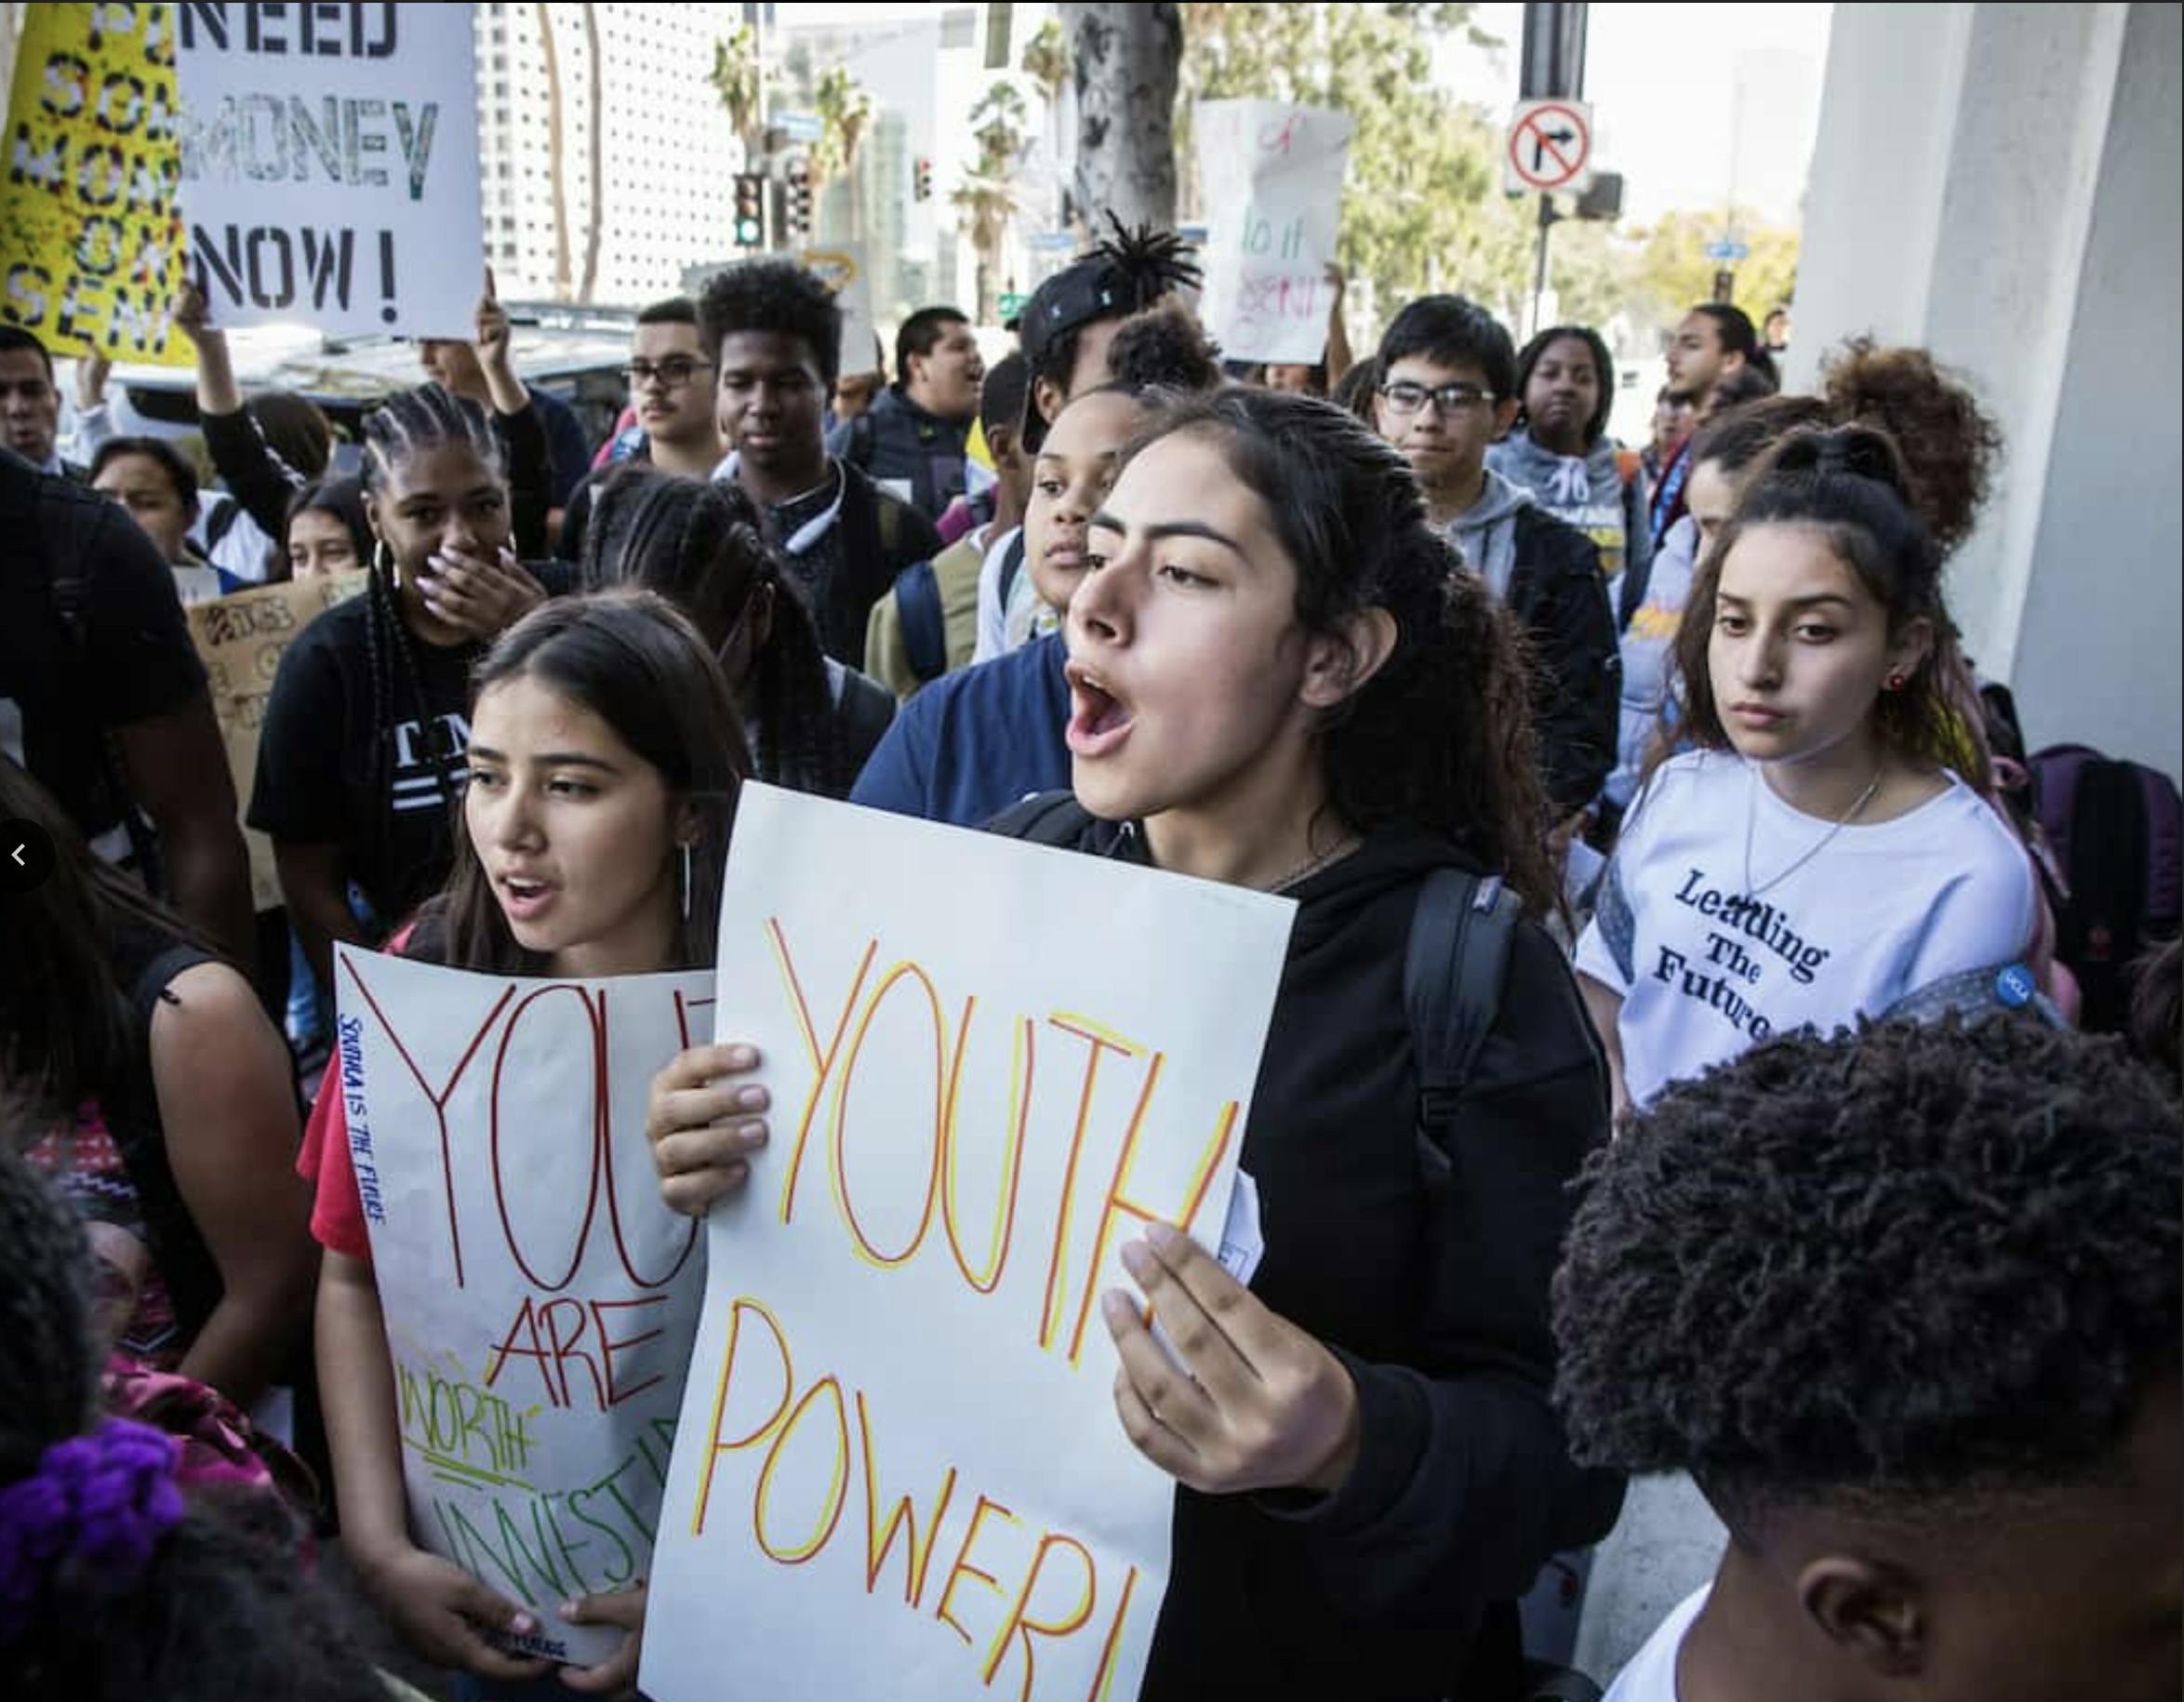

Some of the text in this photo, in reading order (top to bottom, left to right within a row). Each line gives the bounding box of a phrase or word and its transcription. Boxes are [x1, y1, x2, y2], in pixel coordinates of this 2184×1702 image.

[180, 3, 397, 58] NEED
[10, 122, 181, 215] MON
[180, 93, 438, 200] MONEY
[192, 223, 397, 324] NOW!
[1675, 868, 1830, 984] Leading
[1705, 932, 1761, 984] The
[1652, 945, 1771, 1043] Future
[340, 951, 715, 1291] YOU
[345, 1093, 367, 1116] IS
[763, 916, 1241, 1369] YOUTH
[486, 1296, 669, 1412] ARE
[398, 1363, 534, 1471] WORTH
